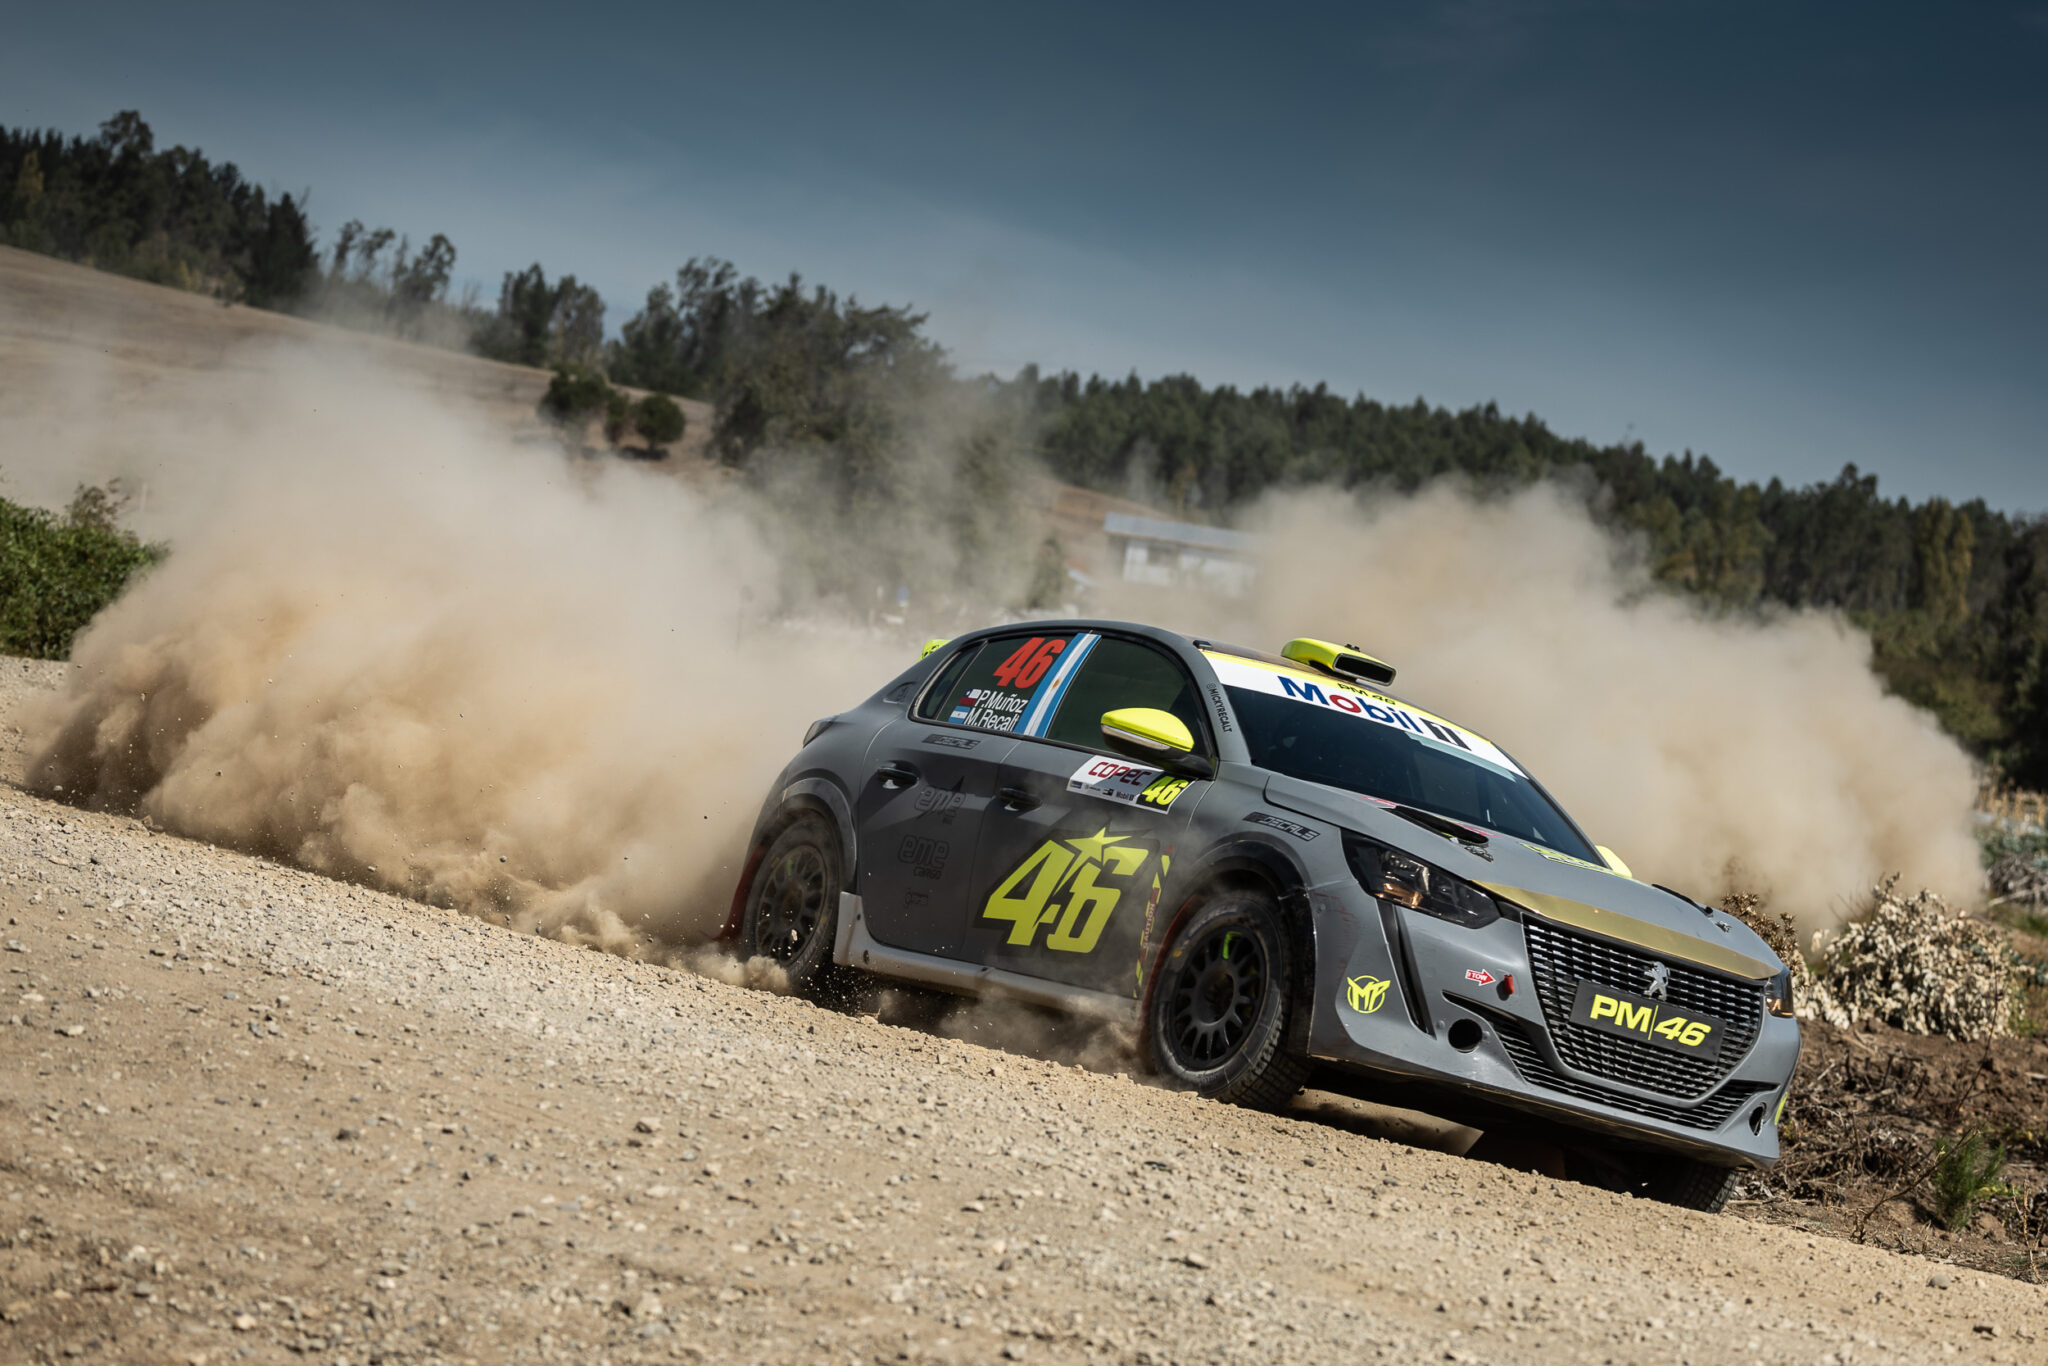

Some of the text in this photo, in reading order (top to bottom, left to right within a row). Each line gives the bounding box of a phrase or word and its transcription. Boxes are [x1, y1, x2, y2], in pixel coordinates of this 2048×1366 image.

[992, 637, 1066, 689] 46
[974, 688, 1029, 714] P.Muñoz
[1277, 675, 1424, 734] Mobil
[1141, 775, 1190, 806] 46
[1259, 816, 1319, 840] DECALS
[983, 838, 1149, 954] 46
[1472, 972, 1489, 982] TOW
